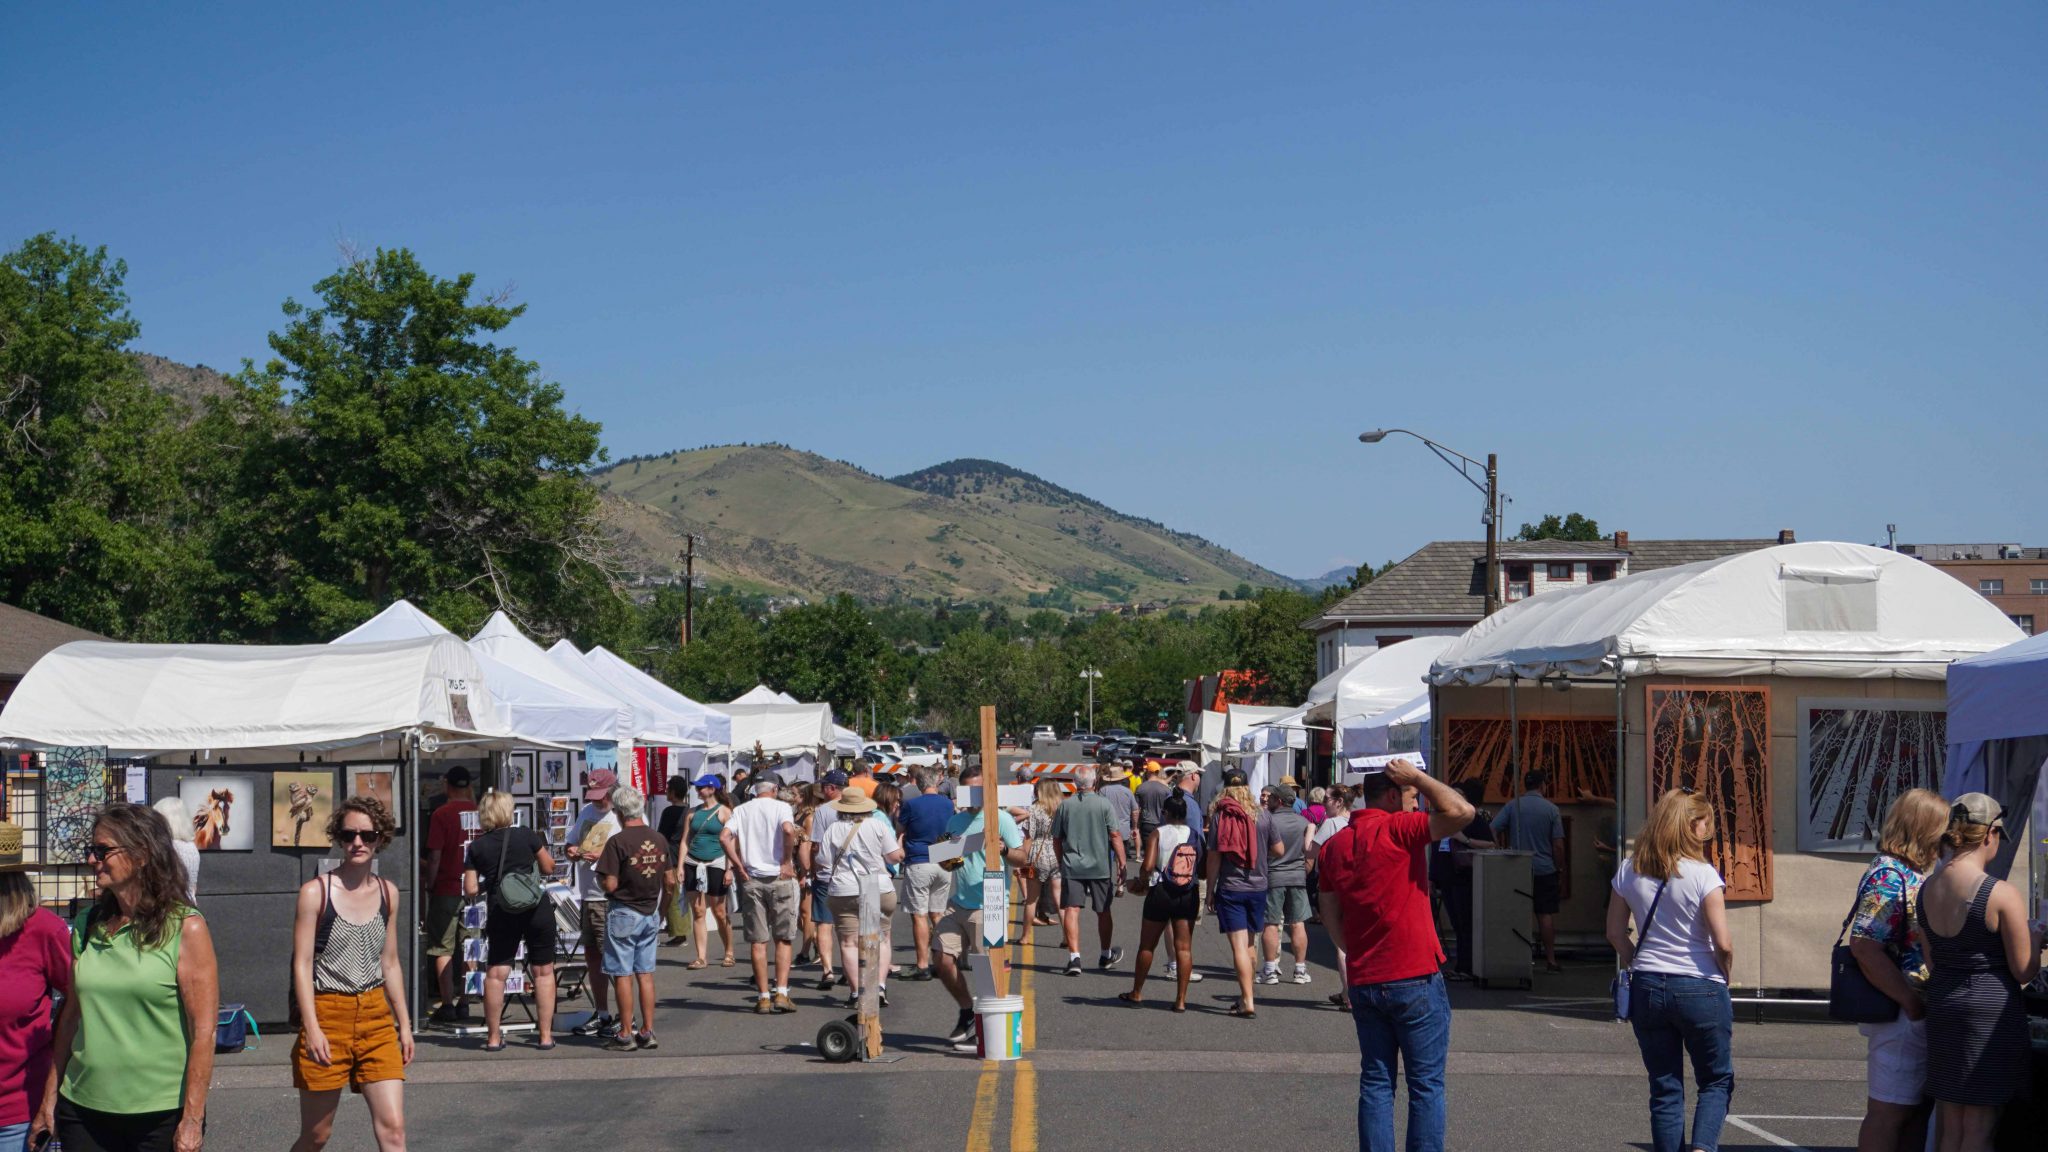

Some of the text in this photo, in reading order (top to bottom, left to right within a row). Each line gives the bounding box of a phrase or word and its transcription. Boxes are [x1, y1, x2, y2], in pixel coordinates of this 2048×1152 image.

[631, 751, 640, 775] Victoria
[655, 770, 664, 792] Victoria
[984, 913, 1000, 921] HERE
